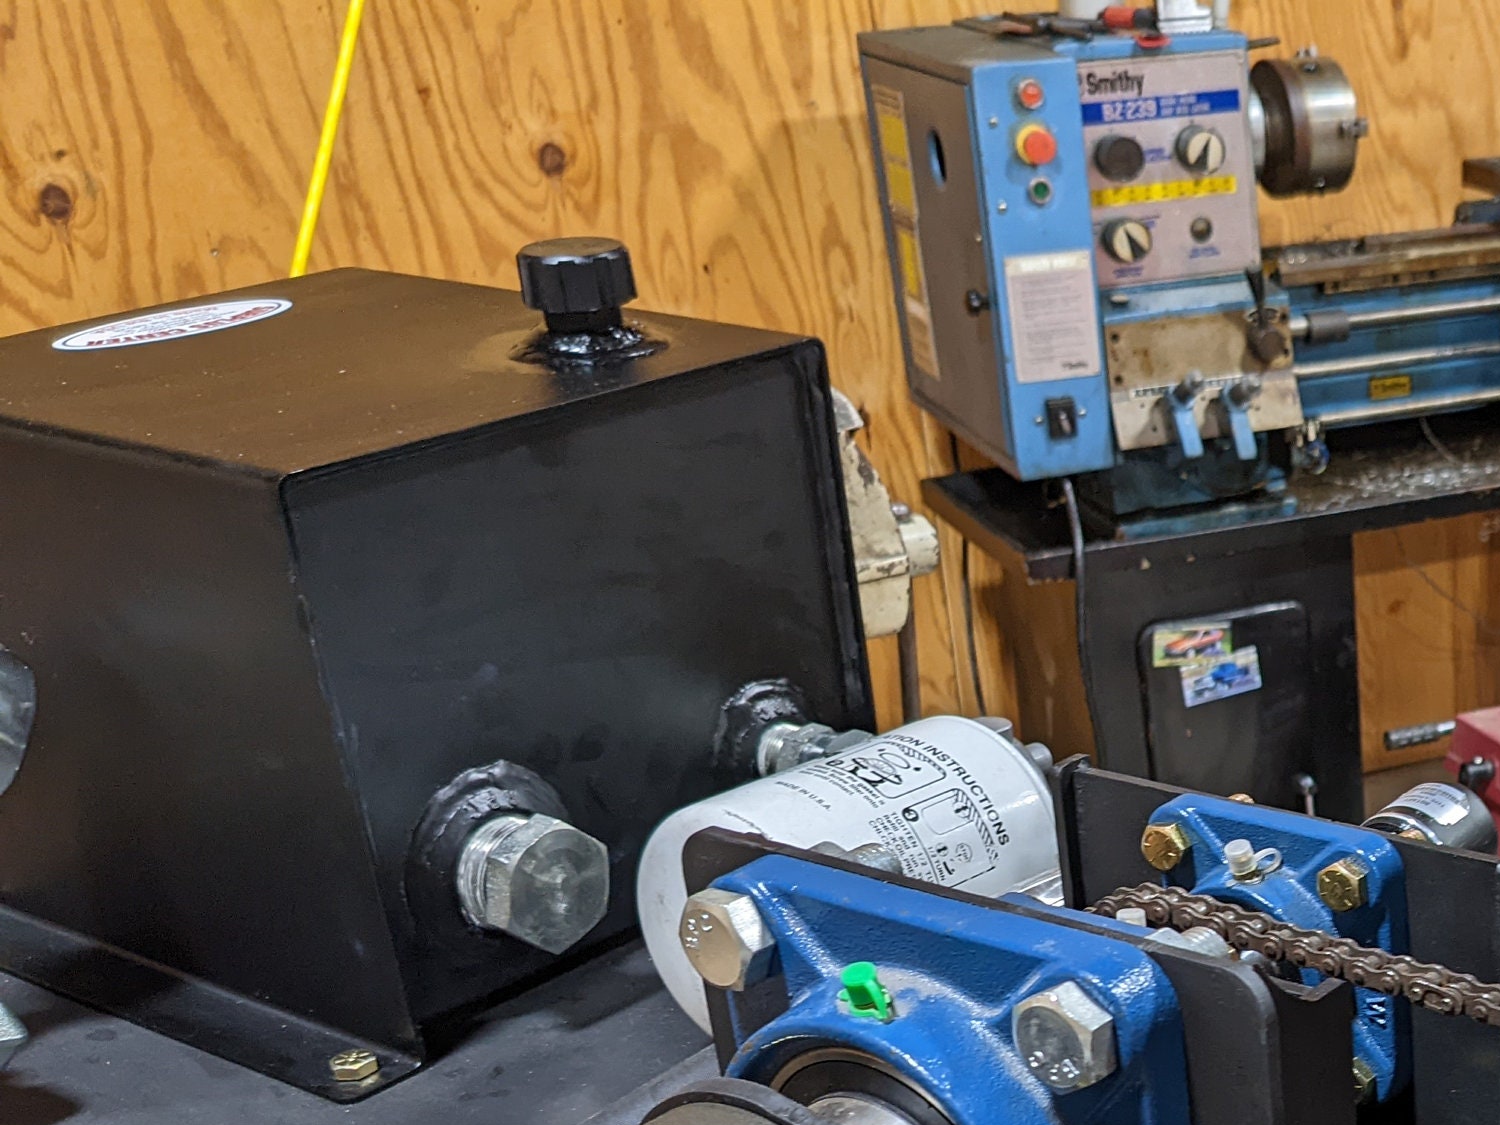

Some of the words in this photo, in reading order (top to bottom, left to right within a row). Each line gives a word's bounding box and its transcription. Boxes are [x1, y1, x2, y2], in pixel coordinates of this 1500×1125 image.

[1086, 71, 1145, 97] Smithy
[924, 743, 1010, 847] INSTRUCTIONS
[875, 817, 899, 844] CHECK
[890, 811, 918, 849] TIGHTEN
